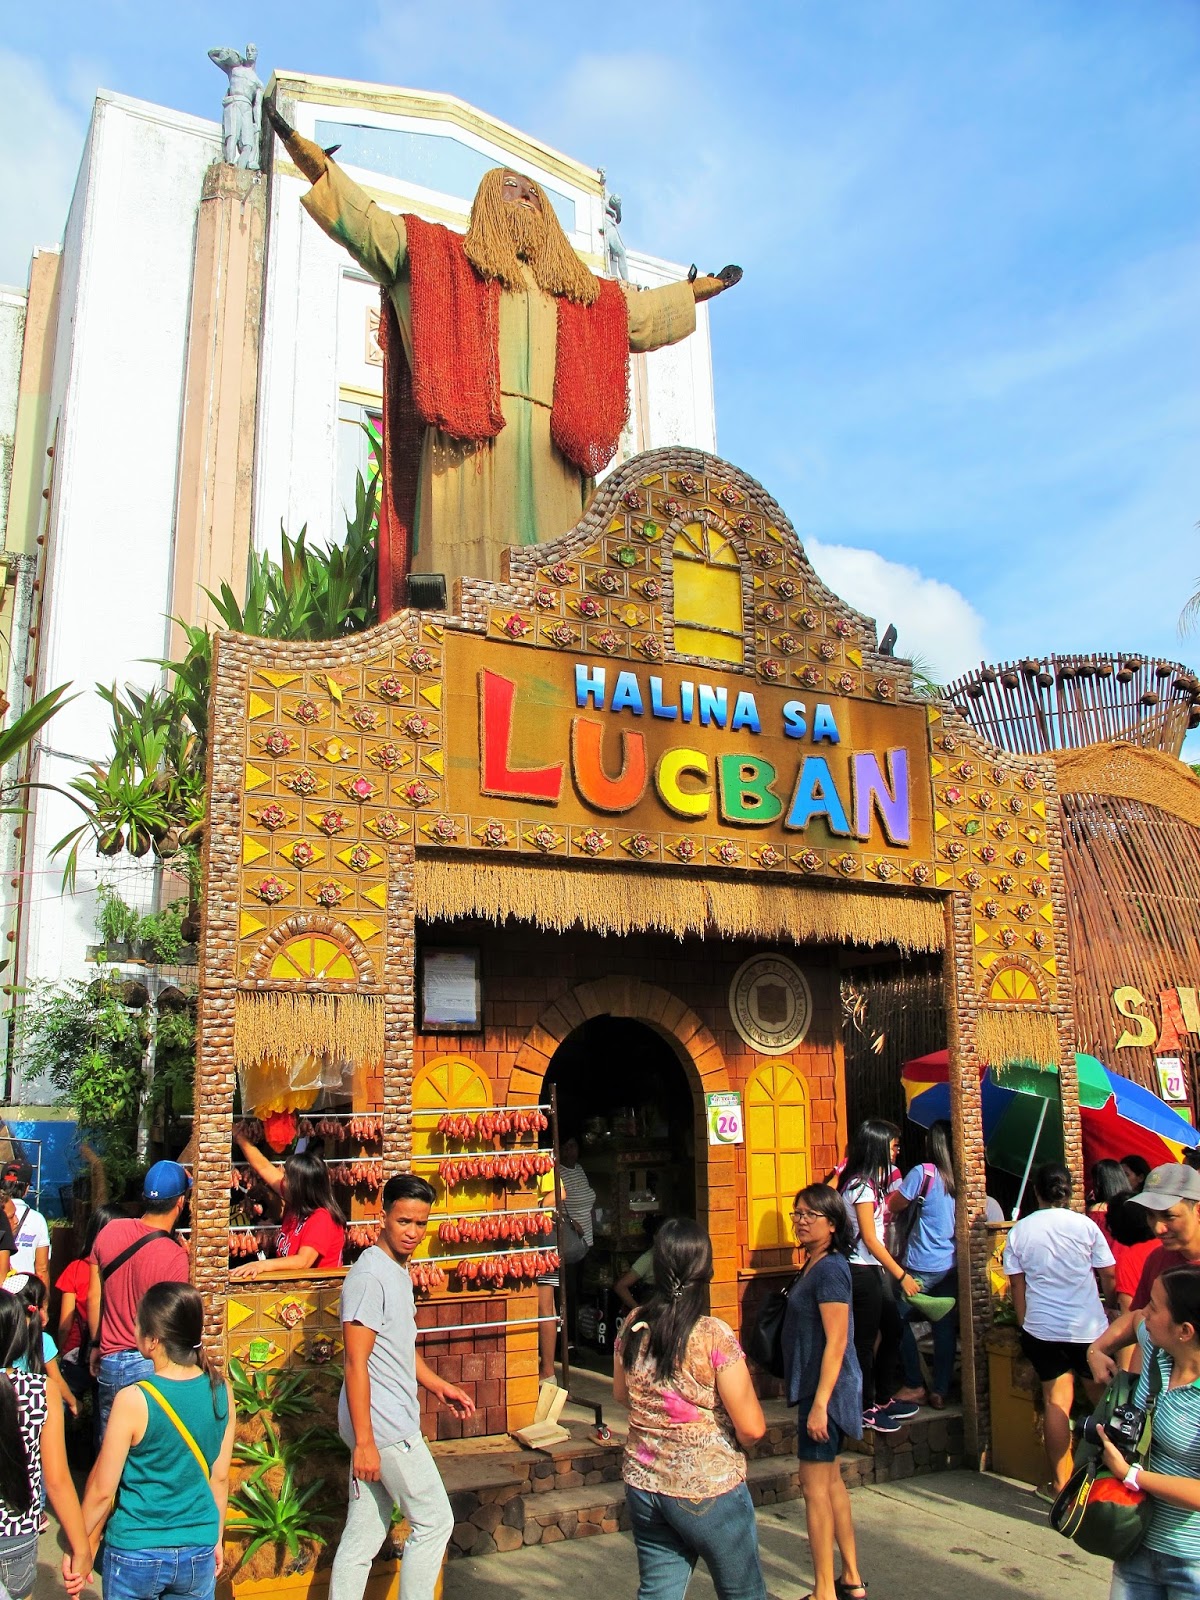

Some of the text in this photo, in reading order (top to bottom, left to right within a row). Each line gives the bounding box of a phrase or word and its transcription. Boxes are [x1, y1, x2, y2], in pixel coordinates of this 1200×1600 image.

[574, 662, 841, 745] HALINA SA
[478, 665, 913, 847] LUCBAN
[739, 1007, 770, 1044] PROVINCE
[783, 1008, 805, 1040] QUEZON
[1167, 1077, 1180, 1091] 27
[718, 1116, 738, 1133] 26
